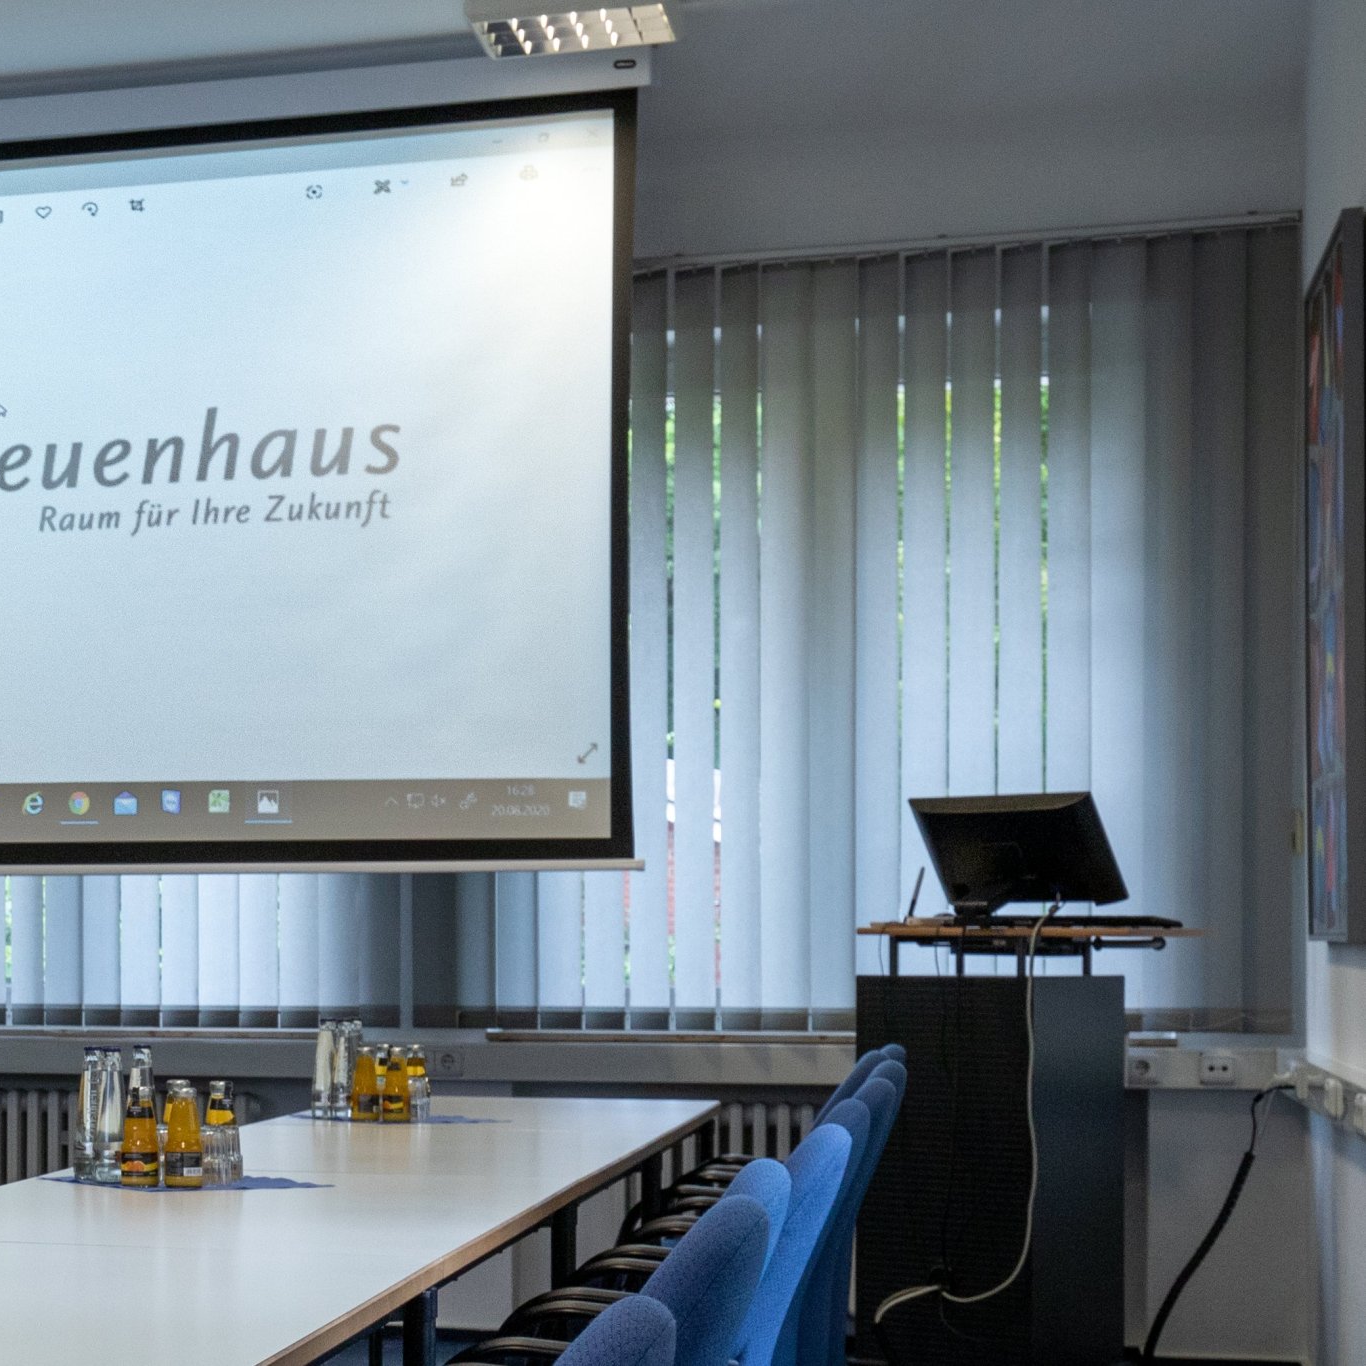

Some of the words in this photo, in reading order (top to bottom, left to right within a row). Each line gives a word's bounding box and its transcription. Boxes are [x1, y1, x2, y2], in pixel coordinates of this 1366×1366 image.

[39, 505, 120, 532] Raum
[131, 499, 179, 536] für
[191, 496, 251, 525] Ihre
[264, 489, 391, 527] Zukunft
